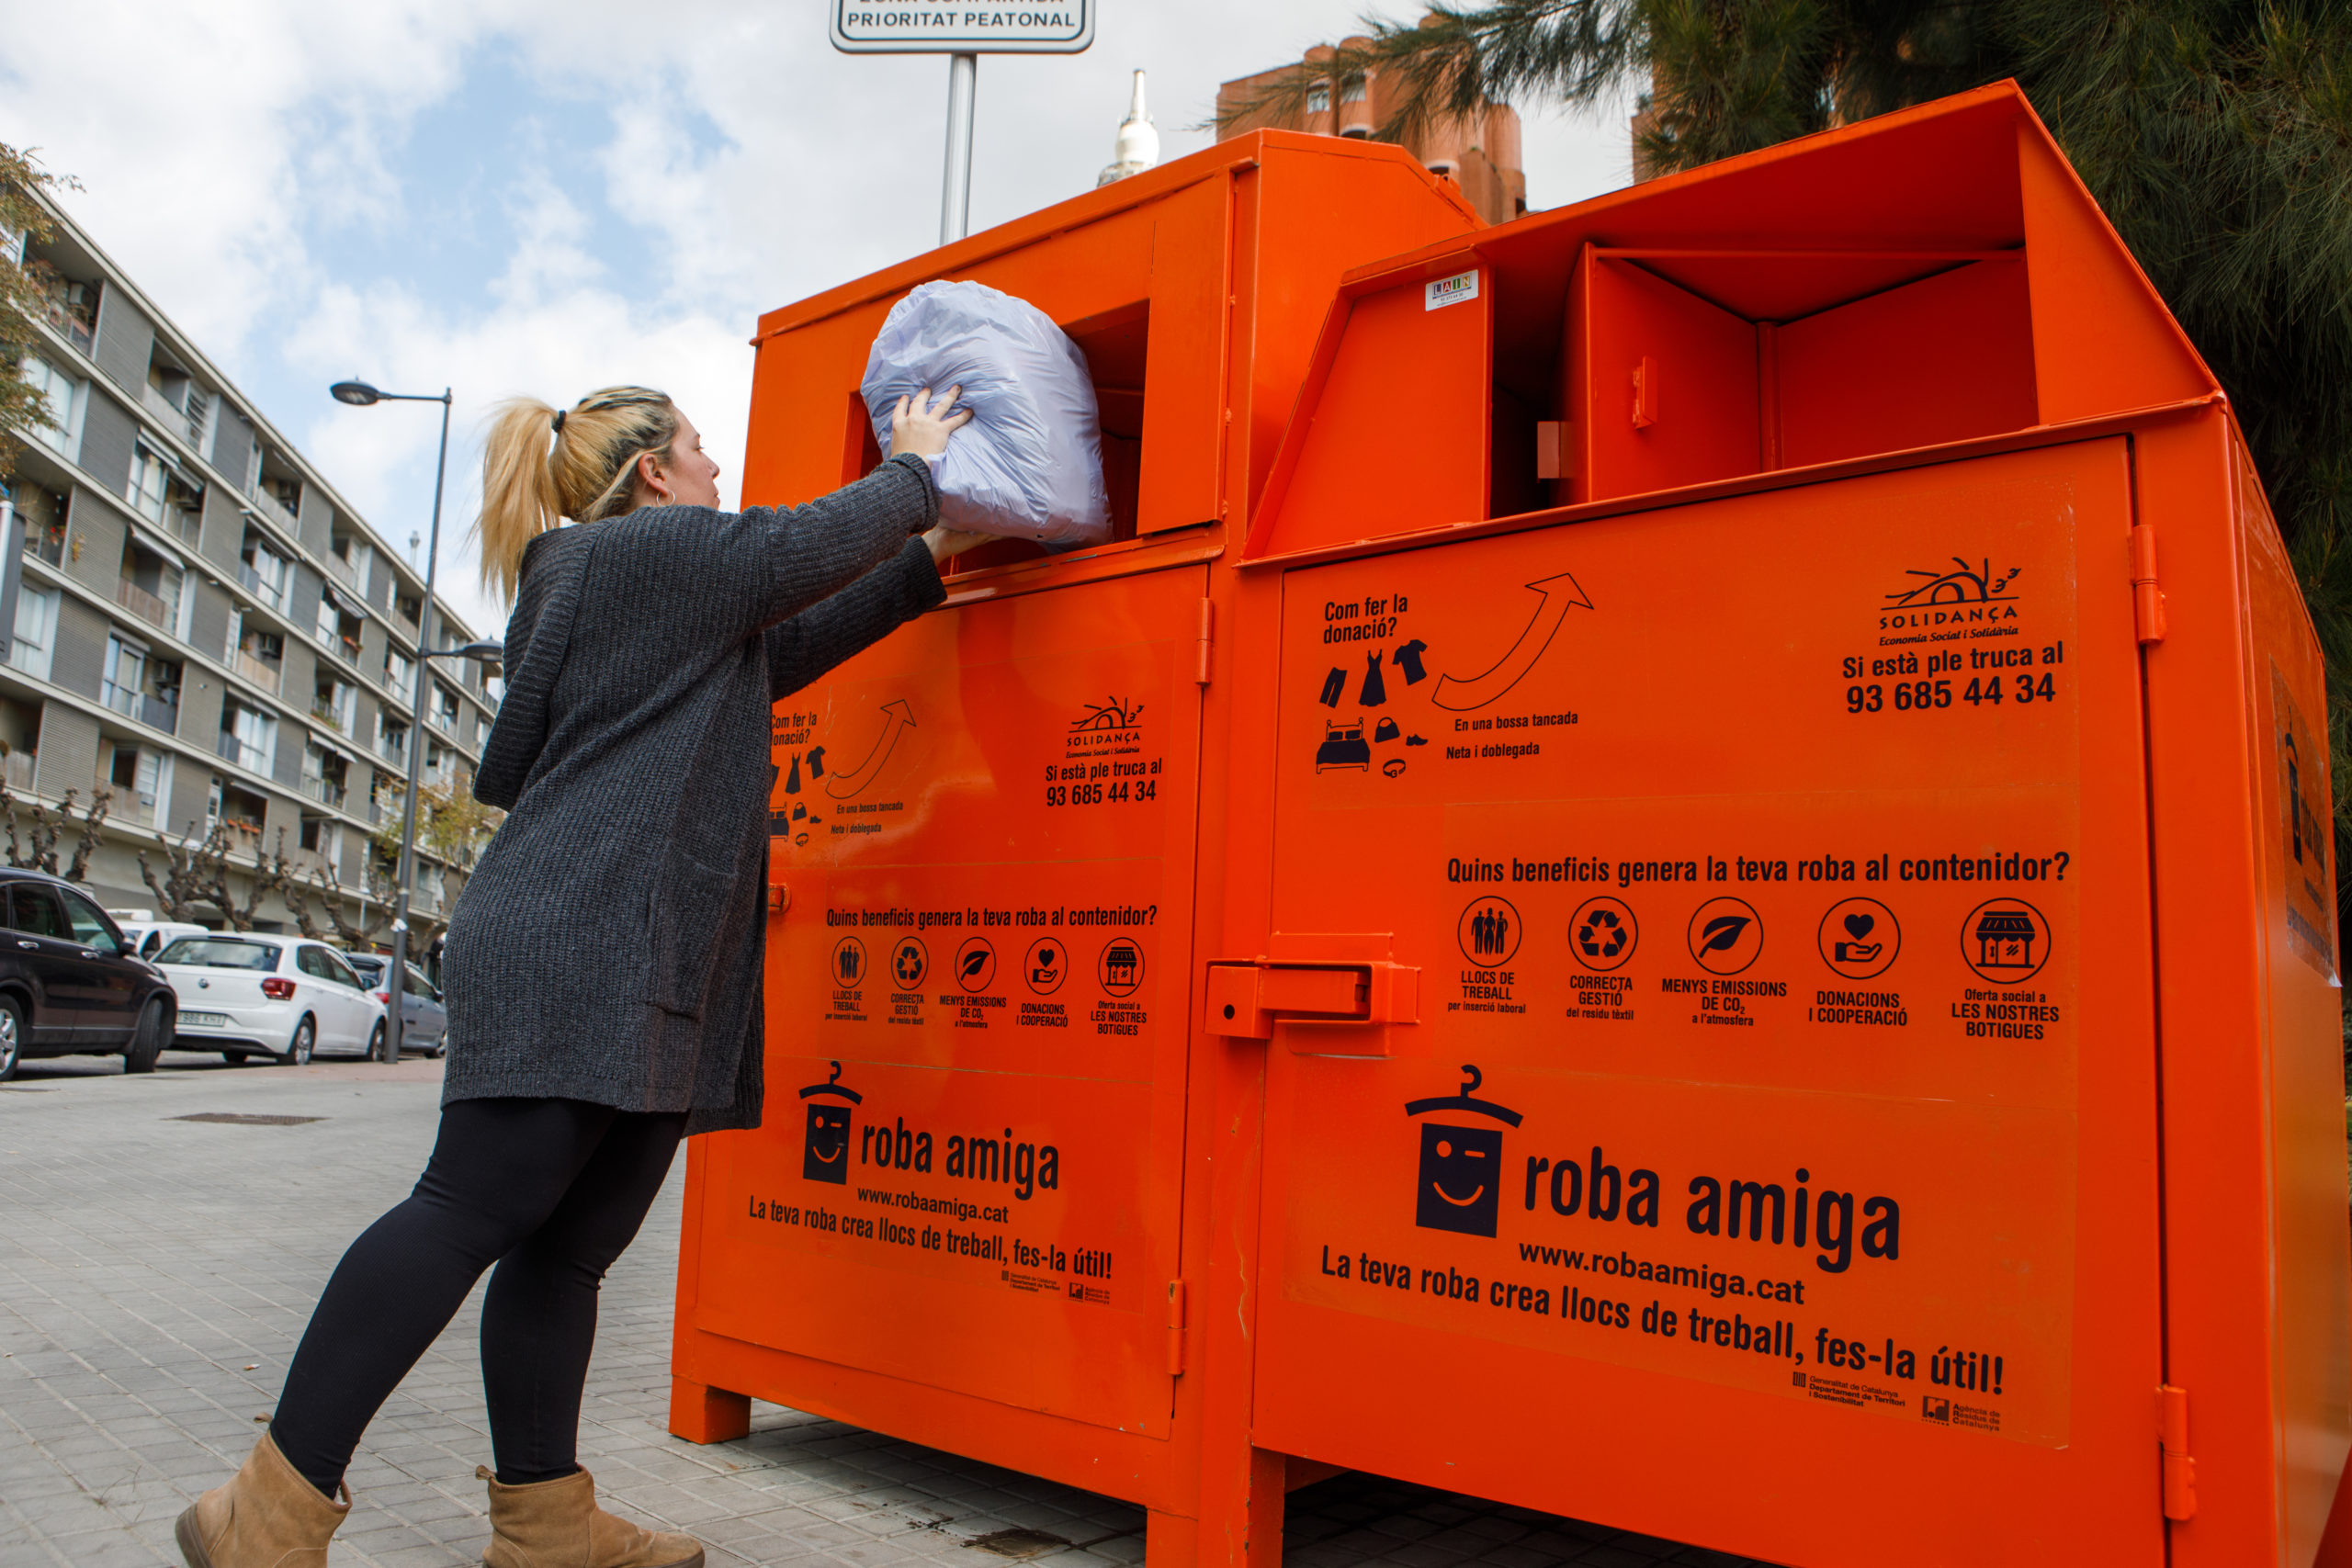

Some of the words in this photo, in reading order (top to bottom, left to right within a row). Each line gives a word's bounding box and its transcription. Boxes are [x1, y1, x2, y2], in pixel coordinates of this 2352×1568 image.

[848, 13, 957, 27] PRIORITAT
[965, 13, 1075, 28] PEATONAL
[1325, 602, 1359, 621] Com
[1364, 597, 1387, 616] fer
[1394, 593, 1408, 613] la
[1880, 605, 2018, 629] SOLIDANÇA
[1324, 617, 1396, 644] donació?
[1880, 634, 1928, 646] Economia
[1929, 631, 1961, 641] Social
[1970, 626, 2018, 638] Solidària
[1843, 656, 1863, 678] Si
[1872, 651, 1918, 676] està
[1928, 649, 1962, 678] ple
[1970, 649, 2032, 669] truca
[2042, 640, 2063, 664] al
[1847, 684, 1883, 713] 93
[1895, 680, 1951, 710] 685
[1963, 676, 2003, 705] 44
[2016, 672, 2056, 703] 34
[793, 713, 806, 728] fer
[808, 712, 817, 726] la
[1455, 719, 1468, 731] En
[1472, 720, 1493, 730] una
[1497, 716, 1528, 728] bossa
[1532, 711, 1577, 727] tancada
[773, 728, 810, 746] onació?
[1068, 732, 1139, 747] SOLIDANÇA
[1446, 747, 1470, 759] Neta
[1482, 742, 1539, 759] doblegada
[1046, 765, 1057, 782] Si
[1061, 762, 1085, 780] està
[1091, 762, 1109, 782] ple
[1114, 761, 1146, 776] truca
[1150, 758, 1161, 773] al
[1047, 786, 1066, 807] 93
[1072, 784, 1102, 805] 685
[1108, 782, 1129, 803] 44
[1135, 780, 1156, 801] 34
[1448, 858, 1504, 883] Quins
[1512, 857, 1609, 882] beneficis
[1619, 862, 1697, 888] genera
[1707, 855, 1727, 881] la
[1736, 856, 1787, 881] teva
[1798, 854, 1855, 881] roba
[1866, 853, 1888, 881] al
[1900, 852, 2070, 881] contenidor?
[827, 908, 858, 926] Quins
[862, 908, 914, 926] beneficis
[919, 912, 962, 931] genera
[967, 908, 978, 926] la
[983, 908, 1011, 926] teva
[1016, 907, 1046, 926] roba
[1052, 907, 1064, 926] al
[1069, 905, 1157, 926] contenidor?
[1462, 971, 1496, 984] LLOCS
[1500, 972, 1514, 985] DE
[1570, 976, 1633, 990] CORRECTA
[833, 991, 852, 1000] LLOCS
[854, 991, 862, 1000] DE
[1463, 986, 1512, 999] TREBALL
[1662, 978, 1707, 994] MENYS
[1713, 980, 1787, 997] EMISSIONS
[1965, 988, 1998, 1001] Oferta
[2002, 990, 2035, 1002] social
[2040, 994, 2046, 1003] a
[833, 1001, 860, 1011] TREBALL
[890, 993, 924, 1004] CORRECTA
[940, 995, 965, 1006] MENYS
[967, 997, 1006, 1007] EMISSIONS
[1098, 1000, 1115, 1010] Oferta
[1117, 1001, 1135, 1010] social
[1447, 1000, 1460, 1012] per
[1464, 1001, 1495, 1012] inserció
[1498, 1003, 1526, 1013] laboral
[1578, 989, 1623, 1007] GESTIÓ
[1702, 997, 1719, 1010] DE
[1817, 991, 1899, 1008] DONACIONS
[895, 1003, 919, 1016] GESTIÓ
[961, 1008, 969, 1018] DE
[1022, 1003, 1065, 1014] DONACIONS
[1091, 1010, 1105, 1021] LES
[1108, 1011, 1147, 1023] NOSTRES
[1566, 1008, 1579, 1017] del
[1582, 1009, 1609, 1019] residu
[1612, 1010, 1634, 1020] tèxtil
[1818, 1008, 1907, 1026] COOPERACIÓ
[1952, 1003, 1980, 1019] LES
[1986, 1004, 2059, 1021] NOSTRES
[1021, 1014, 1068, 1027] COOPERACIÓ
[1098, 1023, 1137, 1035] BOTIGUES
[1966, 1021, 2043, 1040] BOTIGUES
[862, 1117, 933, 1173] roba
[946, 1128, 1058, 1201] amiga
[858, 1188, 1008, 1224] www.robaamiga.cat
[1525, 1146, 1659, 1227] roba
[1687, 1168, 1899, 1273] amiga
[750, 1195, 765, 1219] La
[771, 1200, 799, 1225] teva
[805, 1207, 836, 1232] roba
[842, 1216, 873, 1238] crea
[879, 1217, 915, 1246] llocs
[922, 1225, 941, 1250] de
[946, 1229, 1007, 1266] treball,
[1013, 1239, 1066, 1271] fes-la
[1074, 1247, 1111, 1279] útil!
[1519, 1243, 1804, 1312] www.robaamiga.cat
[1322, 1246, 1350, 1279] La
[1360, 1253, 1410, 1290] teva
[1421, 1267, 1479, 1303] roba
[1490, 1281, 1549, 1315] crea
[1562, 1286, 1630, 1328] llocs
[1642, 1301, 1677, 1337] de
[1689, 1308, 1804, 1366] treball,
[1814, 1326, 1917, 1381] fes-la
[1931, 1346, 2003, 1394] útil!
